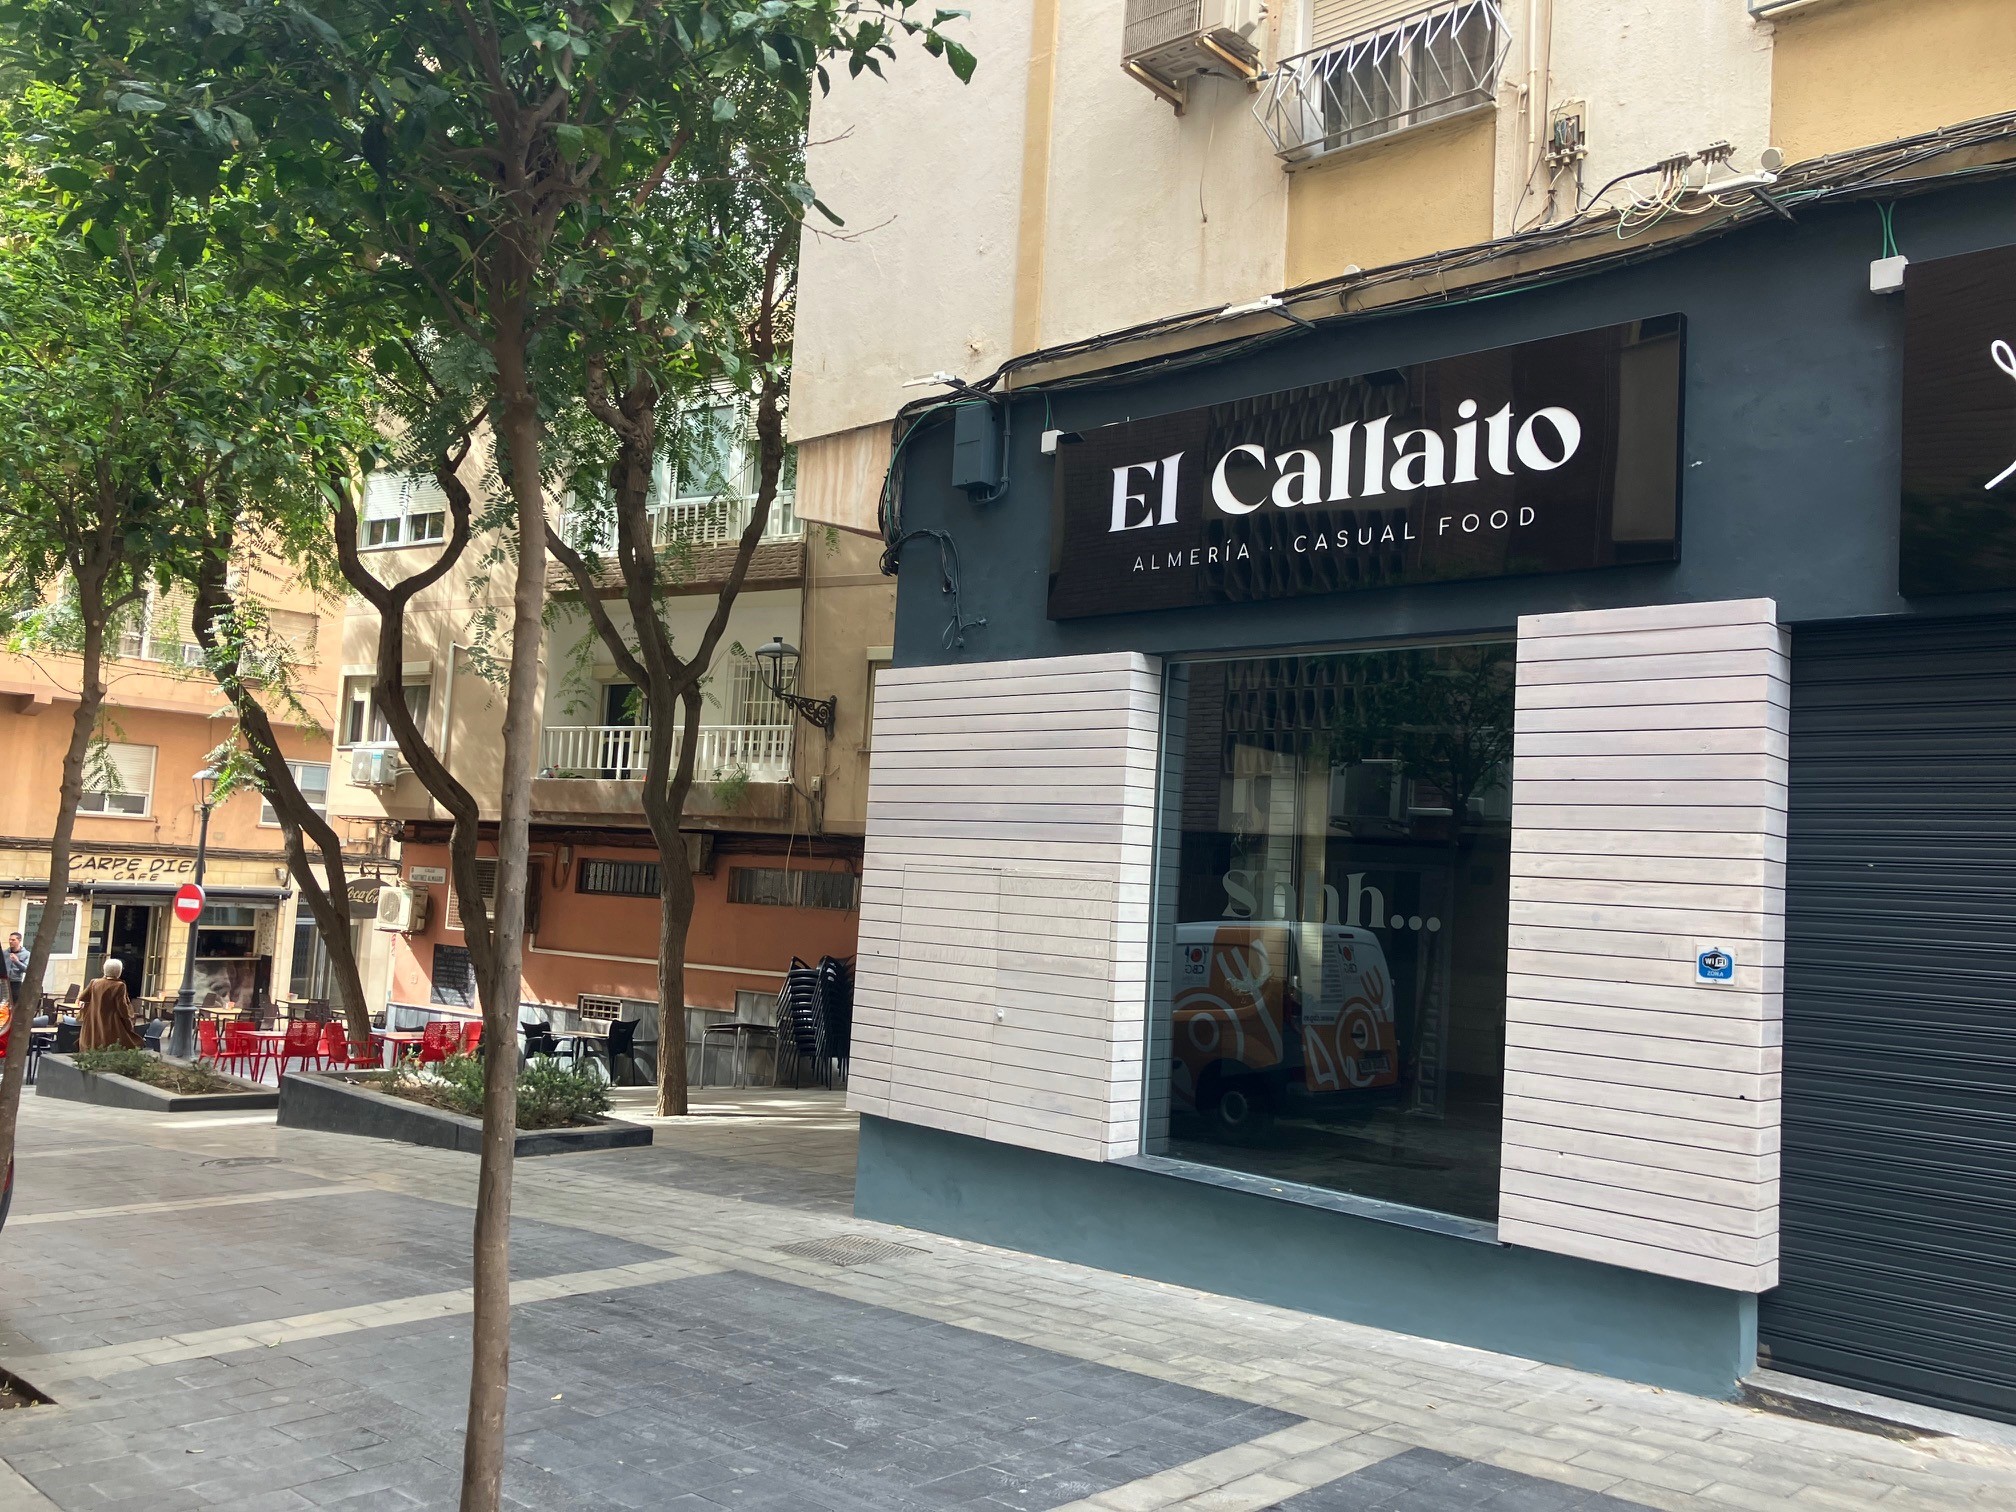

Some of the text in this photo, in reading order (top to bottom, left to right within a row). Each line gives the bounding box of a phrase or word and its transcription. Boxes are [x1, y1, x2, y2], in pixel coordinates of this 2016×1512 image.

[1107, 398, 1582, 534] El Callaito
[1132, 506, 1537, 573] ALMERÍA CASUAL FOOD
[69, 855, 142, 872] CARPE
[114, 871, 160, 881] CAFE
[1221, 869, 1441, 932] Shhh...
